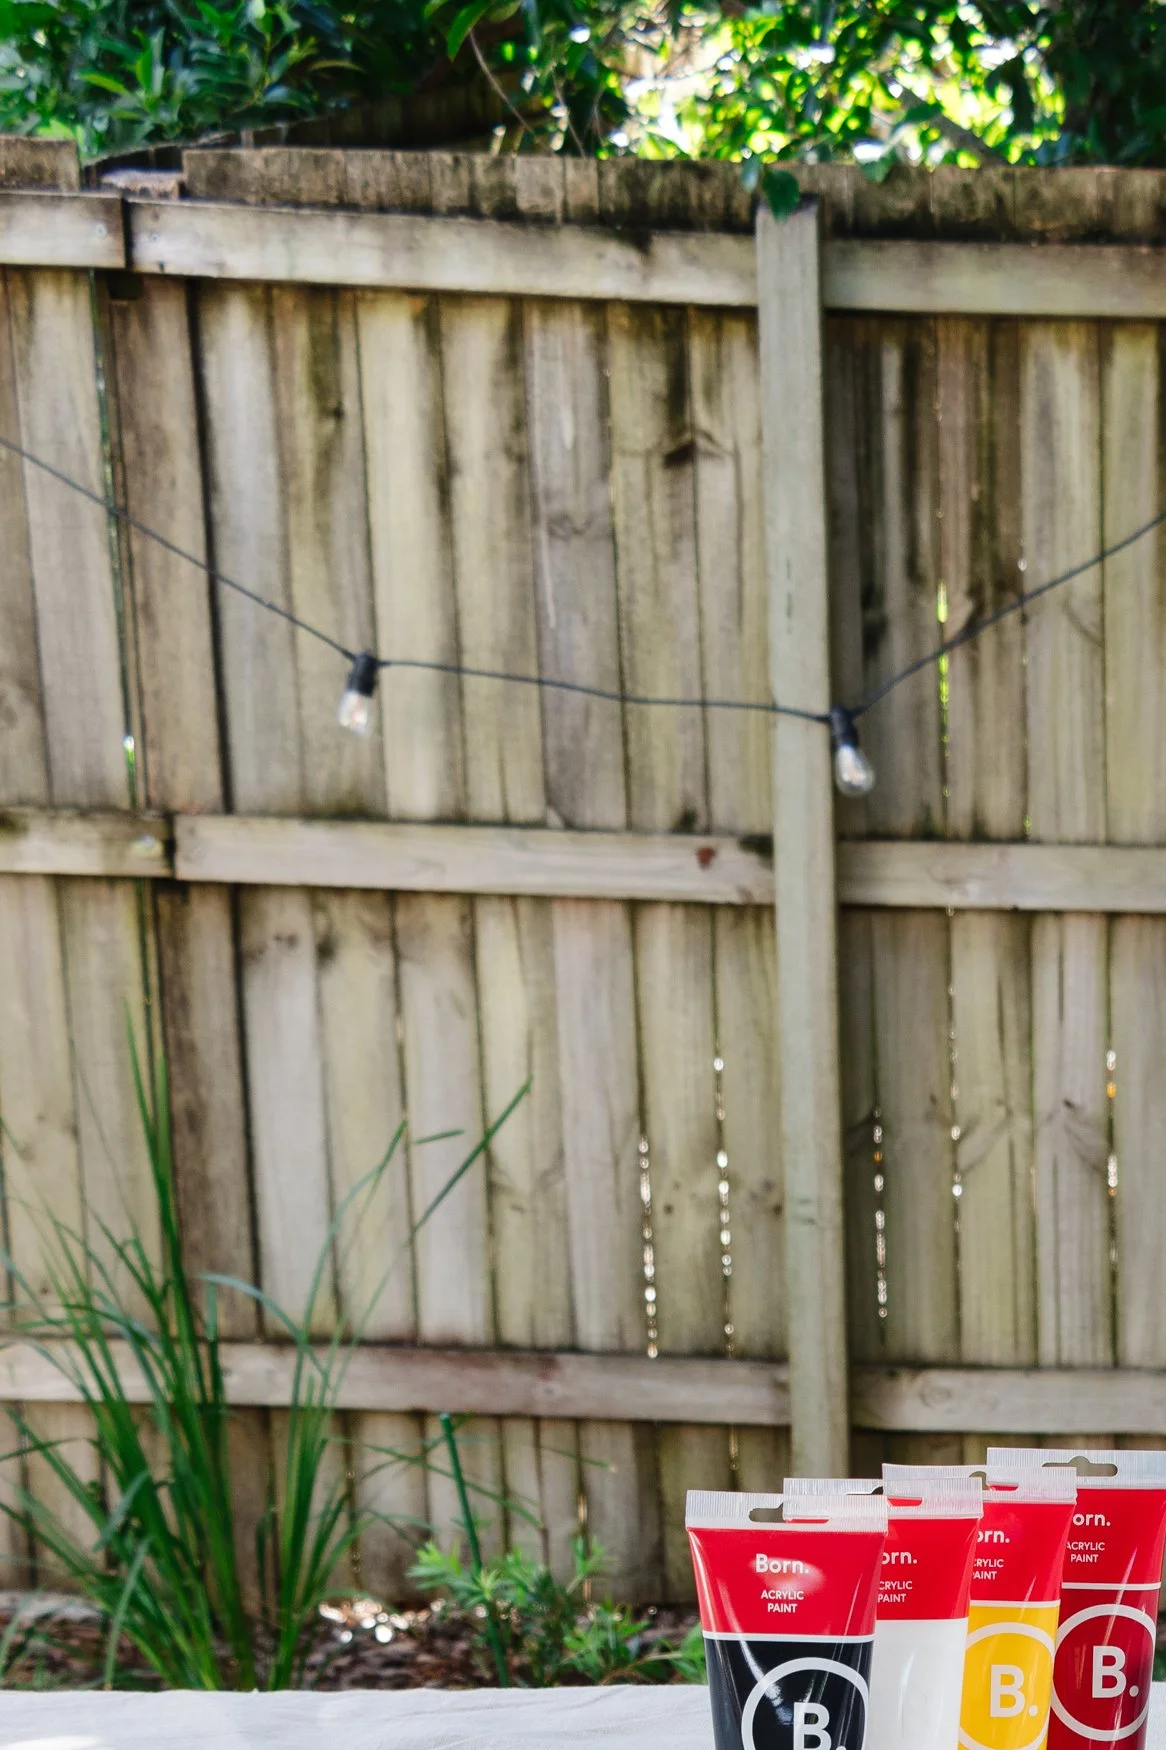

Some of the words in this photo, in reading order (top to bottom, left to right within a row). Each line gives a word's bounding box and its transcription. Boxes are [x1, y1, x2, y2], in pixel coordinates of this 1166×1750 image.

[1072, 1513, 1111, 1527] orn.
[881, 1551, 918, 1565] orn.
[1070, 1554, 1099, 1563] PAINT
[755, 1553, 810, 1574] Born.
[973, 1571, 998, 1580] AINT
[878, 1581, 913, 1590] CRYLIC
[760, 1590, 805, 1600] ACRYLIC
[877, 1594, 907, 1603] PAINT
[767, 1603, 798, 1613] PAINT
[1091, 1645, 1140, 1699] B.
[989, 1664, 1039, 1718] B.
